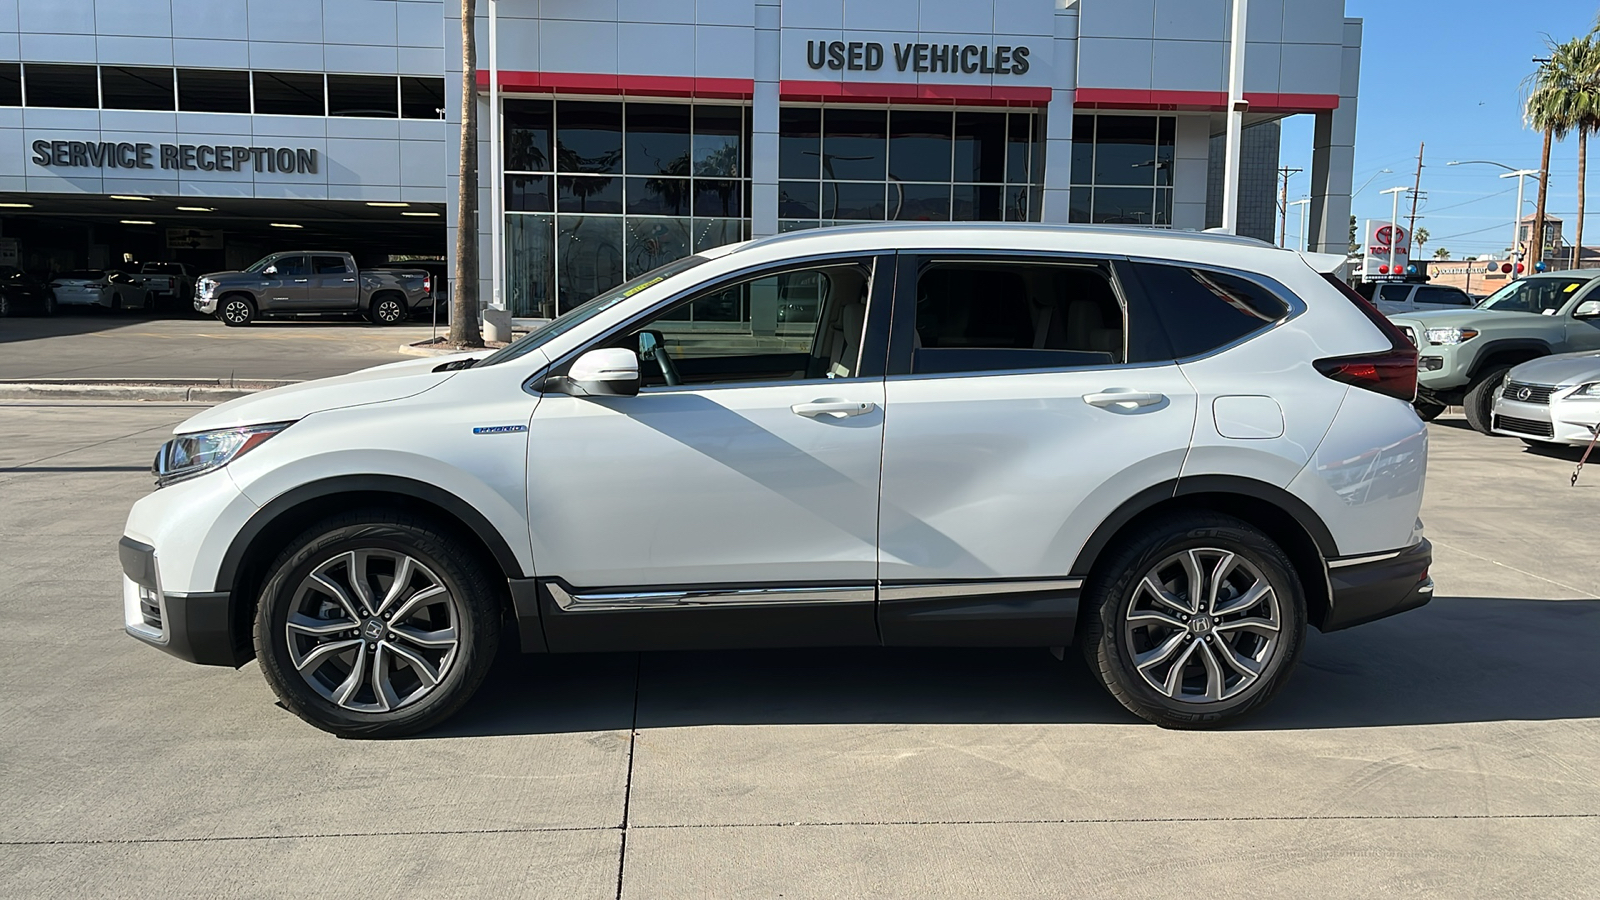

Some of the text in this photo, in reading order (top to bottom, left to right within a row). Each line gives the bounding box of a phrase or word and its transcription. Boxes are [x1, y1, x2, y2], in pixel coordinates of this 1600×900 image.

[807, 40, 1030, 75] USED VEHICLES
[32, 139, 318, 174] SERVICE RECEPTION
[1370, 246, 1407, 254] TOYTA
